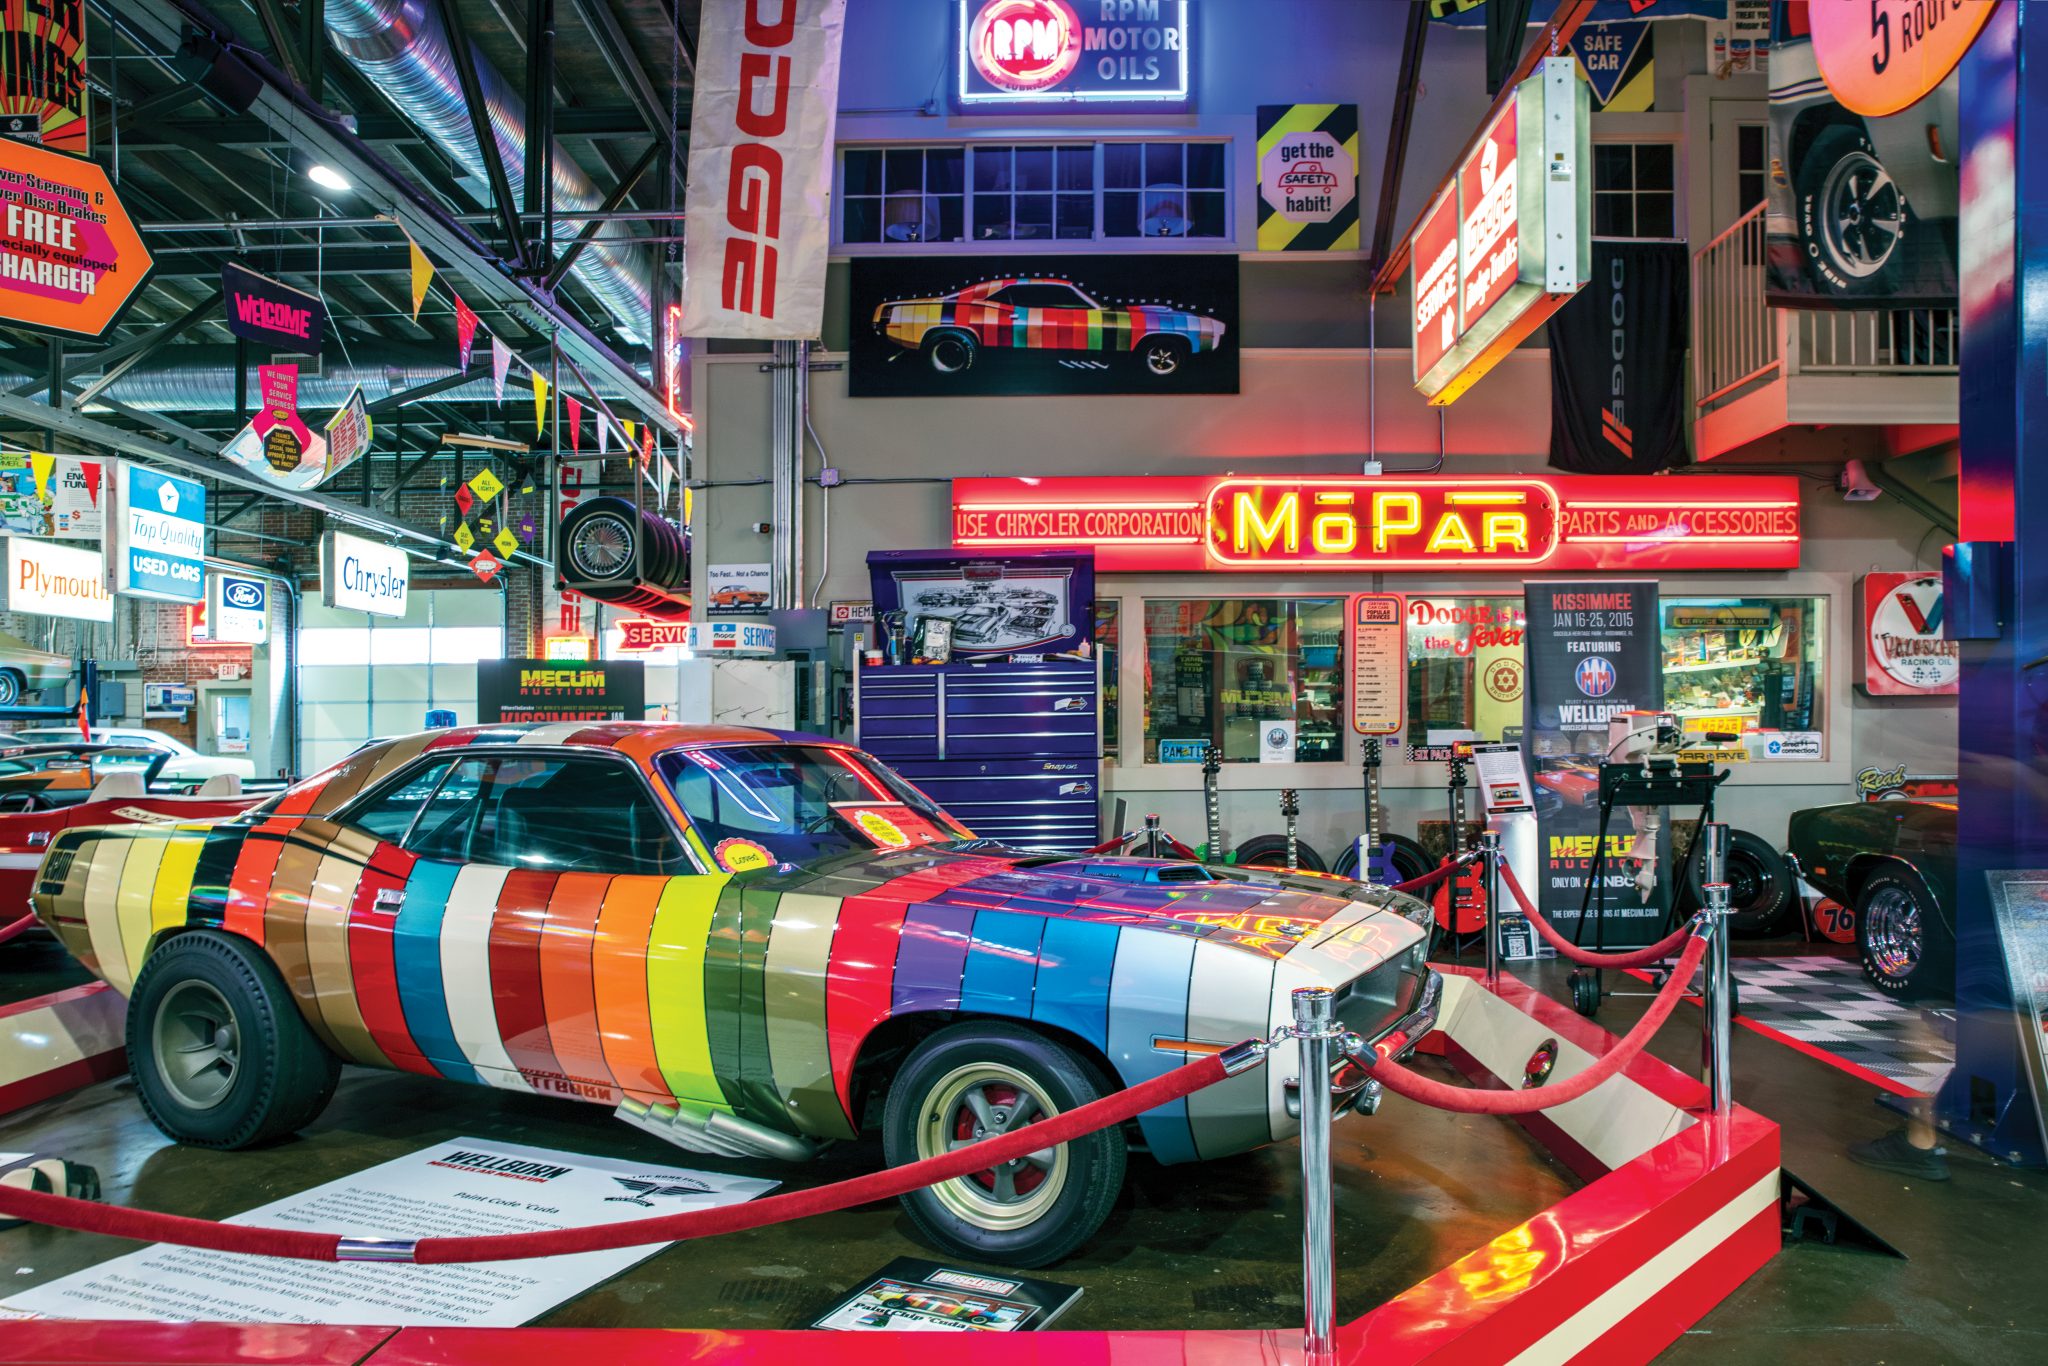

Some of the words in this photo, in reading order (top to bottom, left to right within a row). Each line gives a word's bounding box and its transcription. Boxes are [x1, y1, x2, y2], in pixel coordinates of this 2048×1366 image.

[1100, 0, 1159, 21] RPM
[993, 18, 1059, 61] RPM
[1085, 27, 1179, 50] MOTOR
[1584, 35, 1622, 51] SAFE
[1098, 56, 1160, 80] OILS
[1588, 54, 1620, 71] CAR
[1005, 67, 1067, 91] LUBRICANTS
[1281, 143, 1306, 163] get
[1310, 143, 1334, 158] the
[1285, 174, 1331, 184] SAFETY
[26, 173, 89, 204] Steering
[95, 191, 104, 205] &
[24, 191, 55, 212] Disc
[57, 200, 107, 224] Brakes
[1286, 196, 1331, 212] habit!
[1468, 183, 1512, 254] Dodge
[8, 204, 77, 251] FREE
[53, 251, 117, 273] equipped
[1417, 262, 1457, 332] SERVICE
[235, 292, 312, 339] WELCOME
[1611, 258, 1625, 428] DODGE
[267, 370, 276, 378] WE
[276, 373, 294, 383] INVITE
[273, 381, 288, 390] YOUR
[269, 389, 293, 400] SERVICE
[266, 397, 295, 410] BUSINESS
[957, 514, 988, 537] USE
[995, 513, 1080, 537] CHRYSLER
[1085, 512, 1202, 537] CORPORATION
[1559, 511, 1621, 535] PARTS
[1626, 514, 1658, 531] AND
[1664, 510, 1797, 535] ACCESSORIES
[133, 513, 157, 544] Top
[159, 521, 202, 555] Quality
[133, 555, 168, 576] USED
[170, 562, 201, 583] CARS
[343, 556, 405, 600] Chrysler
[233, 586, 256, 604] Ford
[1552, 593, 1632, 610] KISSIMMEE
[1496, 609, 1510, 622] is
[1553, 613, 1572, 628] JAN
[1575, 612, 1606, 629] 16-25,
[1609, 612, 1634, 627] 2015
[744, 627, 775, 648] SERVICE
[1425, 636, 1450, 649] the
[1454, 625, 1525, 656] fever
[1567, 641, 1621, 652] FEATURING
[222, 664, 235, 676] EXIT
[1901, 658, 1934, 666] RACING
[1938, 658, 1952, 666] OIL
[521, 670, 605, 687] MECUM
[520, 687, 606, 696] AUCTIONS
[1415, 749, 1429, 760] SIX
[1716, 752, 1745, 760] AVE
[732, 853, 759, 865] Loved
[1552, 878, 1569, 888] ONLY
[1570, 878, 1580, 888] ON
[1552, 910, 1562, 918] THE
[1613, 909, 1621, 918] AT
[1621, 908, 1659, 918] MECUM.COM
[1824, 908, 1854, 933] 76
[426, 1160, 499, 1177] MUSCLECAR
[495, 1170, 549, 1184] MUSEUM
[441, 1151, 573, 1179] WELLBORN
[454, 1191, 488, 1201] Paint
[488, 1198, 521, 1207] Code
[450, 1213, 474, 1222] based
[460, 1207, 477, 1215] the
[477, 1211, 511, 1221] coolest
[526, 1219, 549, 1228] that
[441, 1272, 469, 1282] plain
[494, 1281, 522, 1291] 1970
[482, 1270, 520, 1281] Muscle
[520, 1277, 540, 1285] Car
[454, 1295, 495, 1307] options
[490, 1291, 520, 1301] vinyl
[435, 1312, 469, 1323] tastes
[453, 1305, 490, 1316] proof
[853, 1301, 892, 1315] Paint
[889, 1309, 925, 1322] Chip
